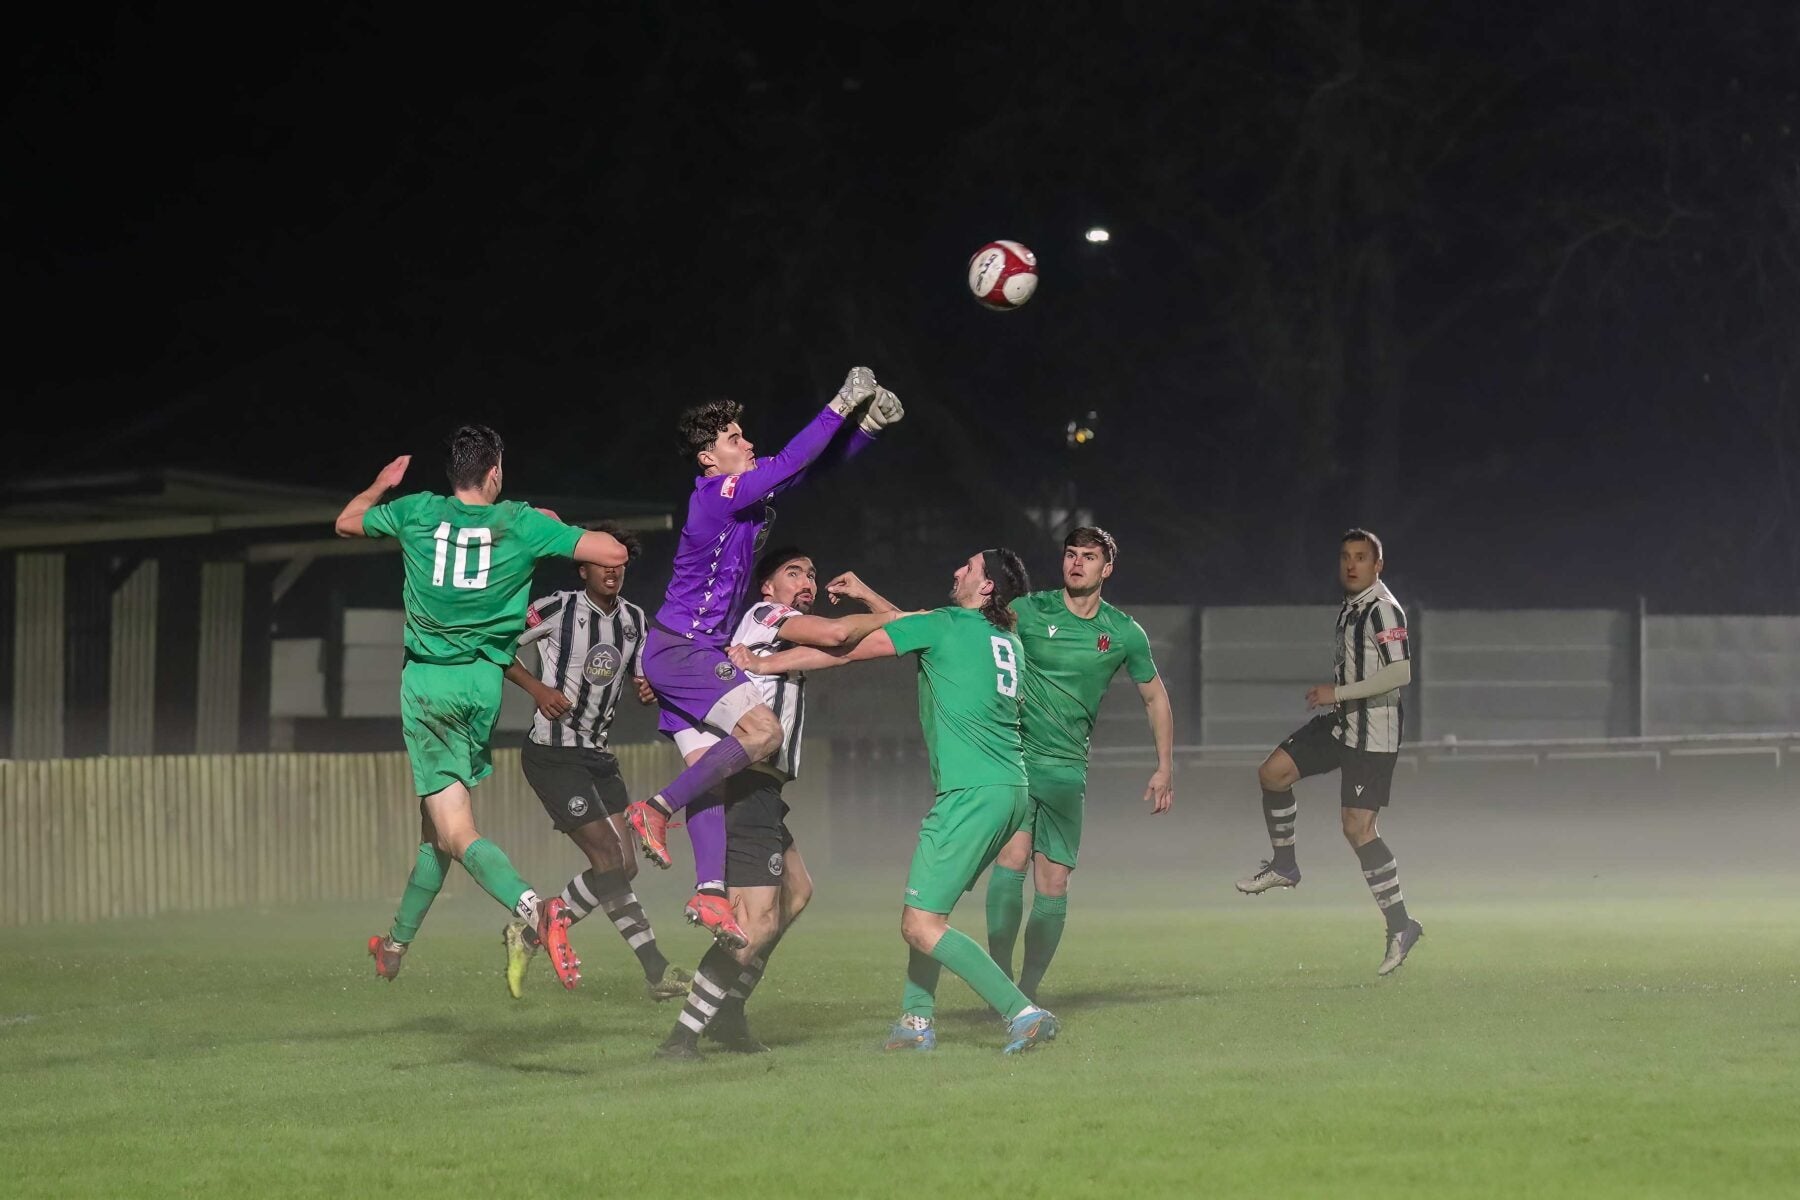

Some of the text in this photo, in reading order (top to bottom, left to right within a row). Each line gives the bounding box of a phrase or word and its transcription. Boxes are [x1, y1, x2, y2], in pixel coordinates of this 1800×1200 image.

[432, 521, 492, 589] 10
[592, 657, 613, 670] arc
[990, 635, 1018, 698] 9
